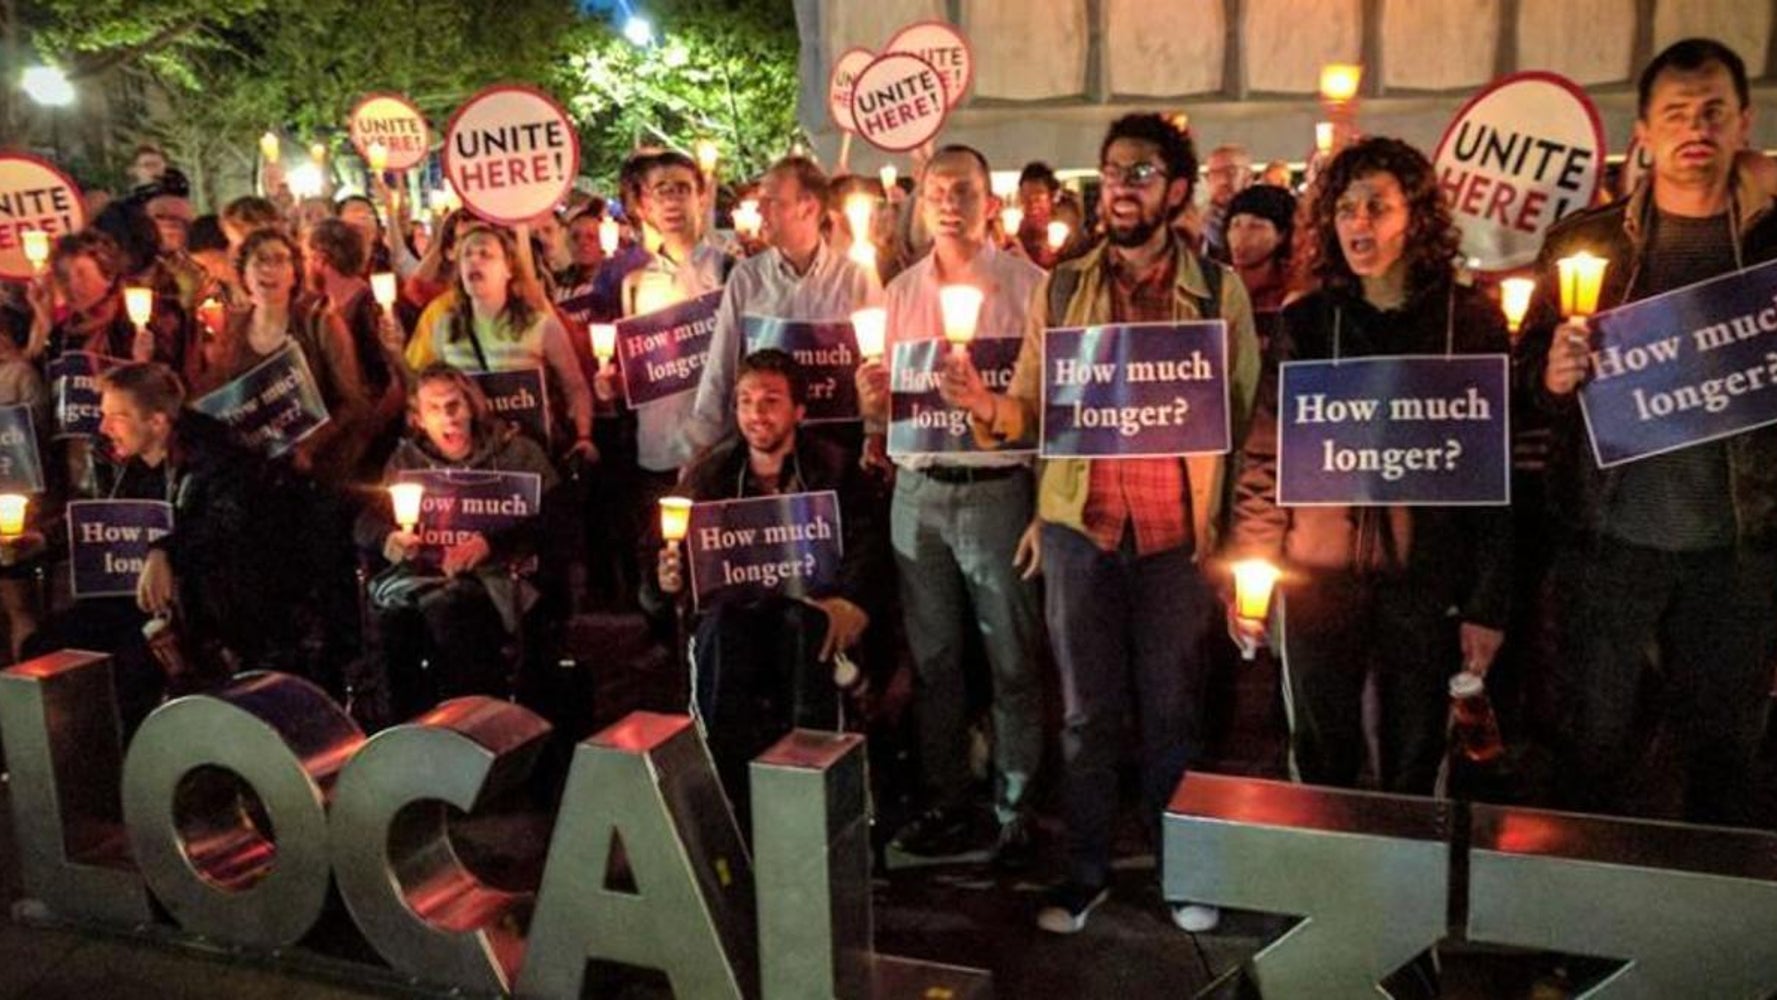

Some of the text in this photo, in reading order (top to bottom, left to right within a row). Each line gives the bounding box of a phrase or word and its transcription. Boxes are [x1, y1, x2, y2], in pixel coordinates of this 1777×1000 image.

[920, 47, 963, 66] ITE
[857, 70, 935, 113] UNITE
[358, 117, 419, 135] UNITE
[864, 93, 941, 136] HERE!
[456, 121, 564, 159] UNITE
[1454, 120, 1592, 191] UNITE
[460, 152, 564, 192] HERE!
[0, 186, 69, 217] NITE
[0, 215, 71, 248] ERE!
[627, 329, 670, 358] How
[1589, 295, 1777, 381] How muc
[900, 367, 946, 390] How
[1055, 351, 1214, 386] How much
[1632, 352, 1777, 421] longer?
[911, 402, 975, 437] long
[1072, 397, 1190, 437] longer?
[1295, 386, 1491, 426] How much
[1323, 438, 1463, 481] longer?
[422, 493, 528, 516] ow much
[81, 521, 142, 543] How
[699, 514, 832, 551] How much
[722, 552, 816, 588] longer?
